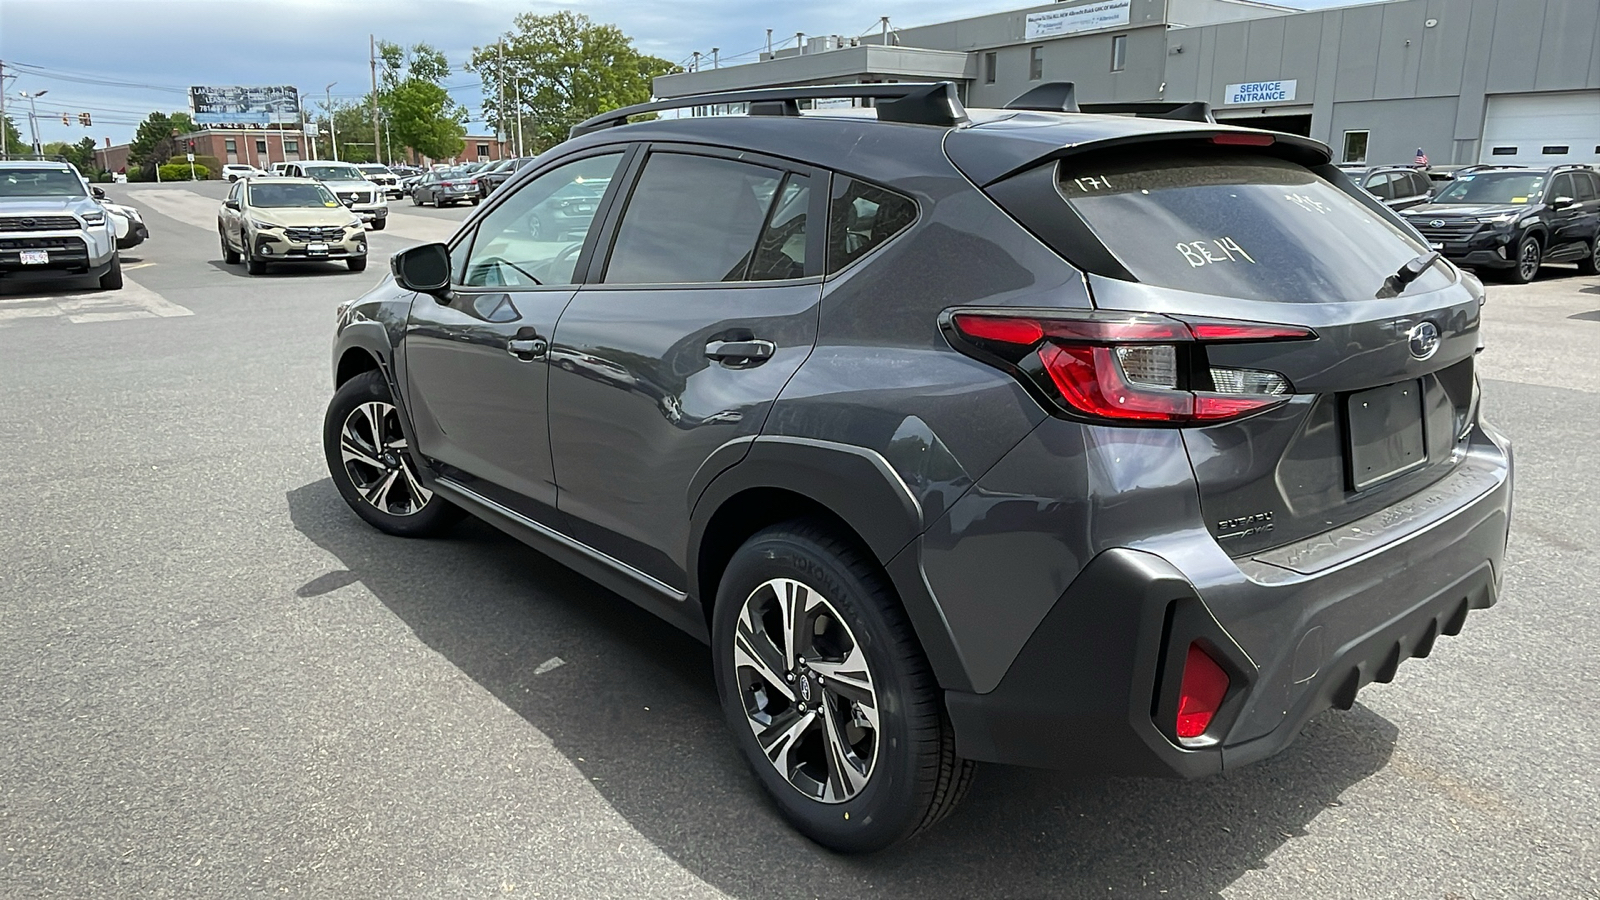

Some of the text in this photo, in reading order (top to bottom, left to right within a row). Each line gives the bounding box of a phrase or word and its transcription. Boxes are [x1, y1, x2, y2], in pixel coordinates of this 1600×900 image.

[1240, 82, 1281, 93] SERVICE
[1233, 91, 1286, 103] ENTRANCE
[1074, 175, 1112, 192] 171
